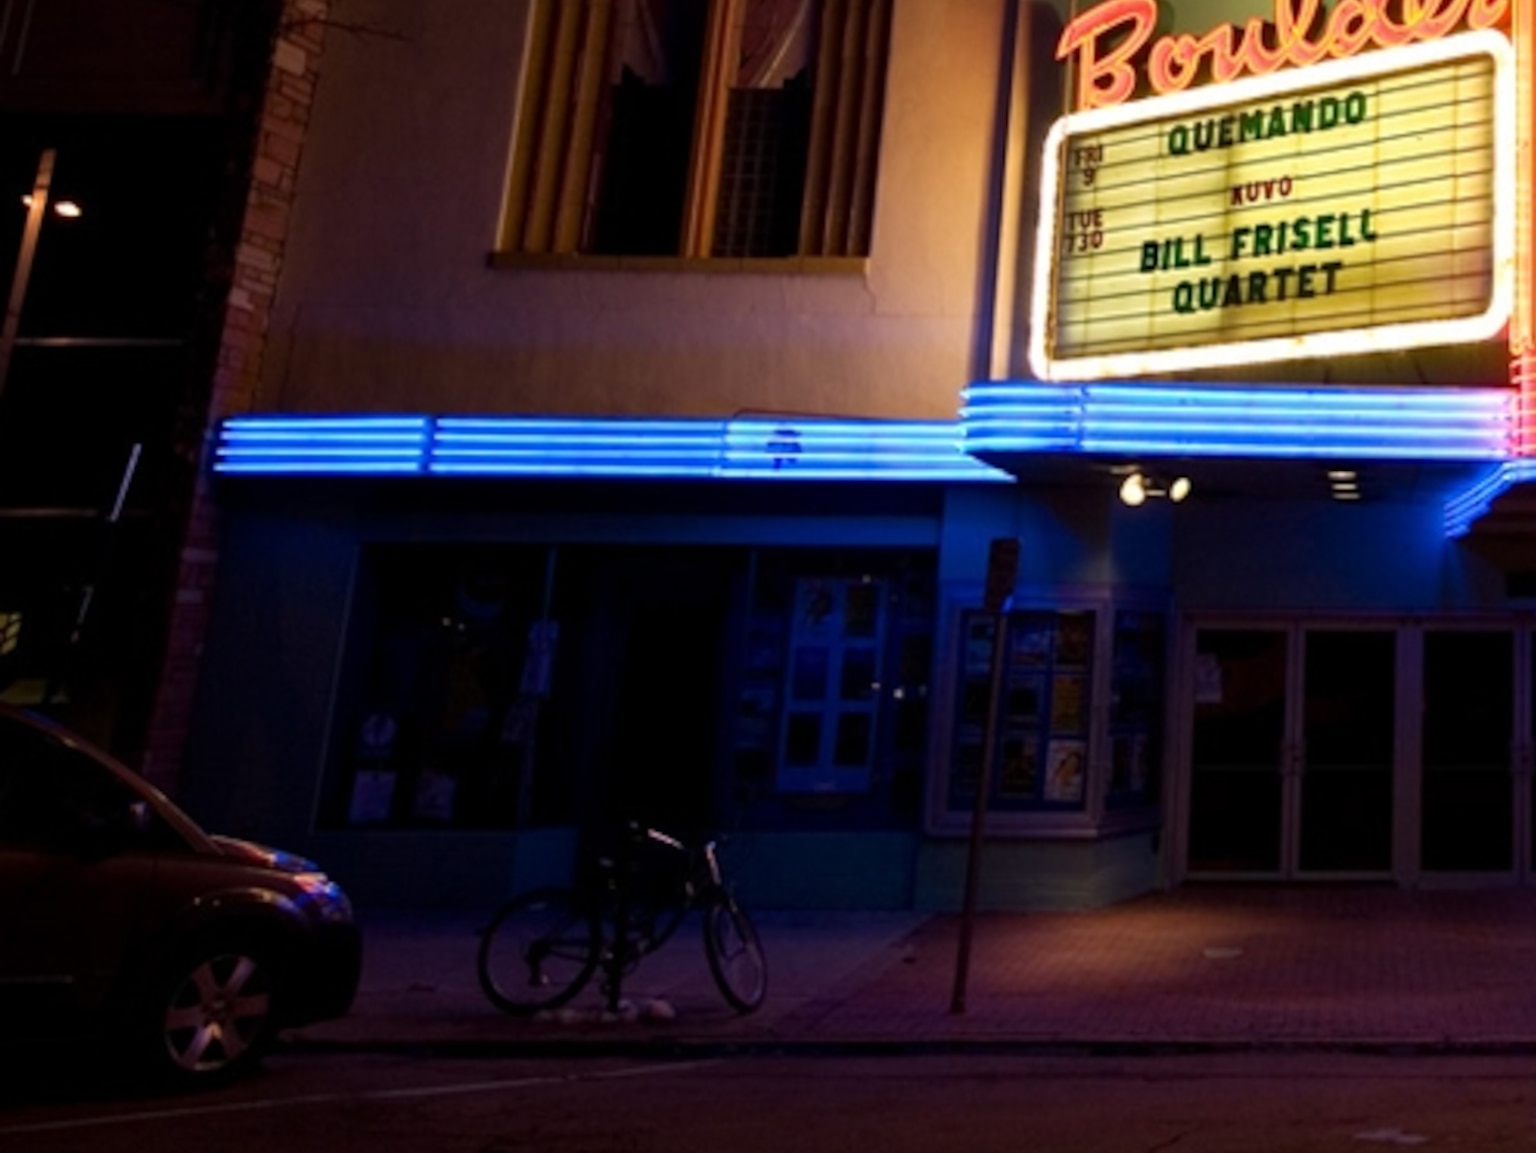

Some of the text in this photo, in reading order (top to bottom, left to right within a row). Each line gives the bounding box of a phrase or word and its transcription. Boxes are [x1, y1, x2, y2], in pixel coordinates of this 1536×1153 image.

[1168, 91, 1367, 155] QUEMANDO
[1074, 144, 1103, 166] FRI
[1083, 168, 1096, 186] 9
[1231, 175, 1293, 205] KUVO
[1065, 208, 1103, 231] TUE
[1139, 209, 1377, 273] BILL FRISELL
[1173, 262, 1343, 314] QUARTET
